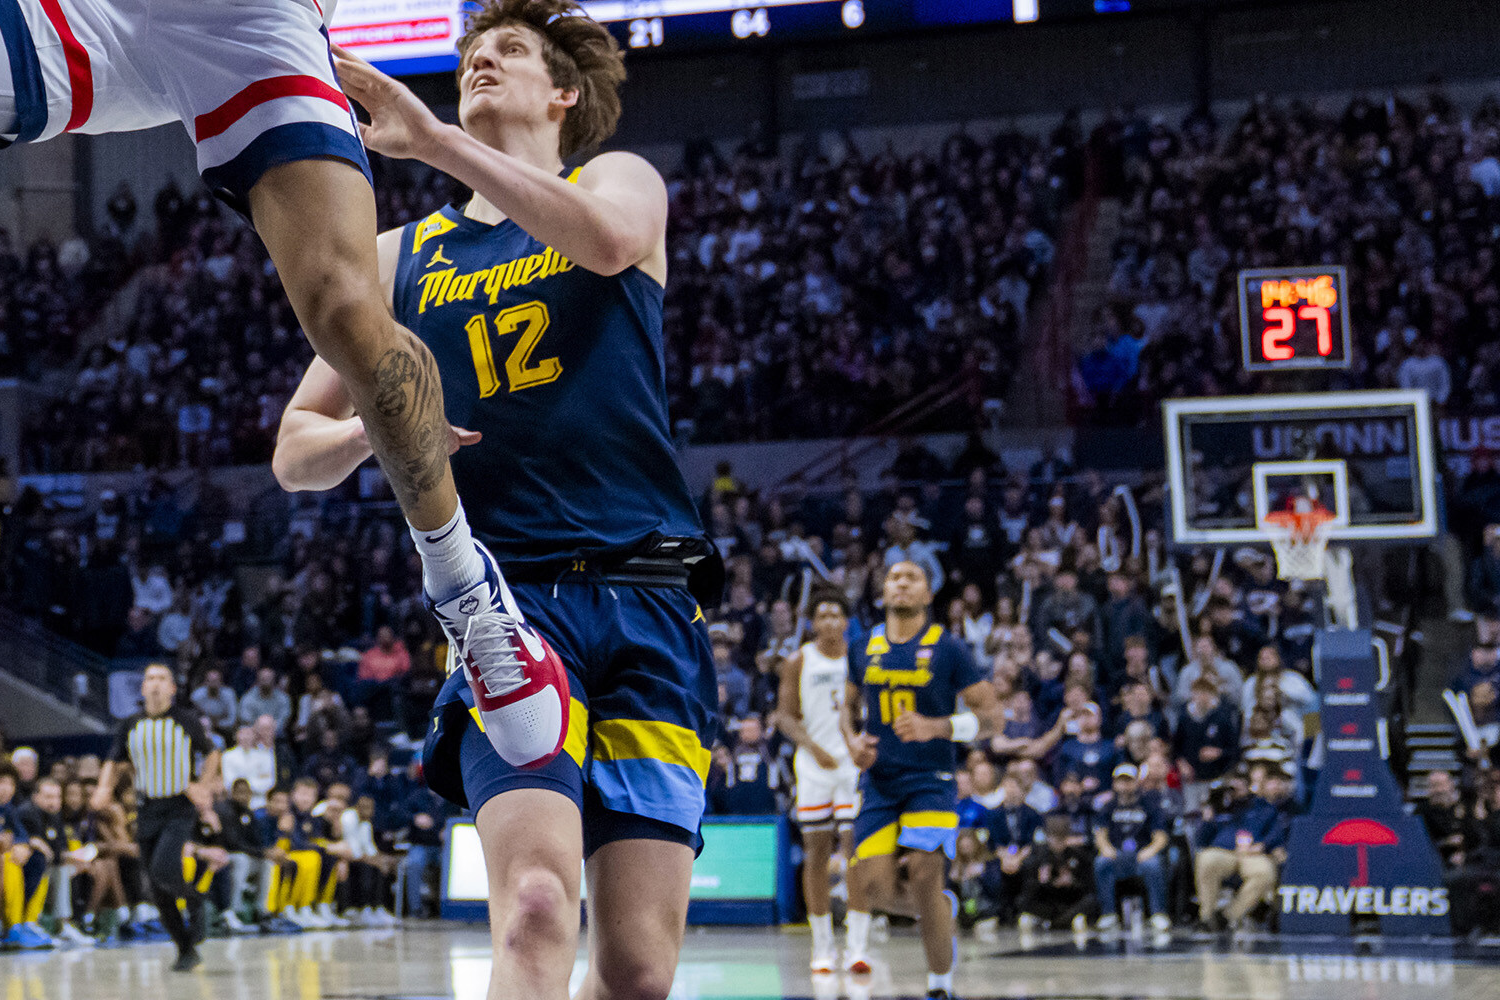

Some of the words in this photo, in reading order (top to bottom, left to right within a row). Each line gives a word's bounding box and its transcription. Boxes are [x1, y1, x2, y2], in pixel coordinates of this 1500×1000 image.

[629, 17, 663, 48] 21
[731, 8, 771, 39] 64
[417, 245, 575, 315] Marquett
[464, 300, 563, 399] 12
[1262, 305, 1332, 361] 27
[1278, 885, 1450, 916] TRAVELERS
